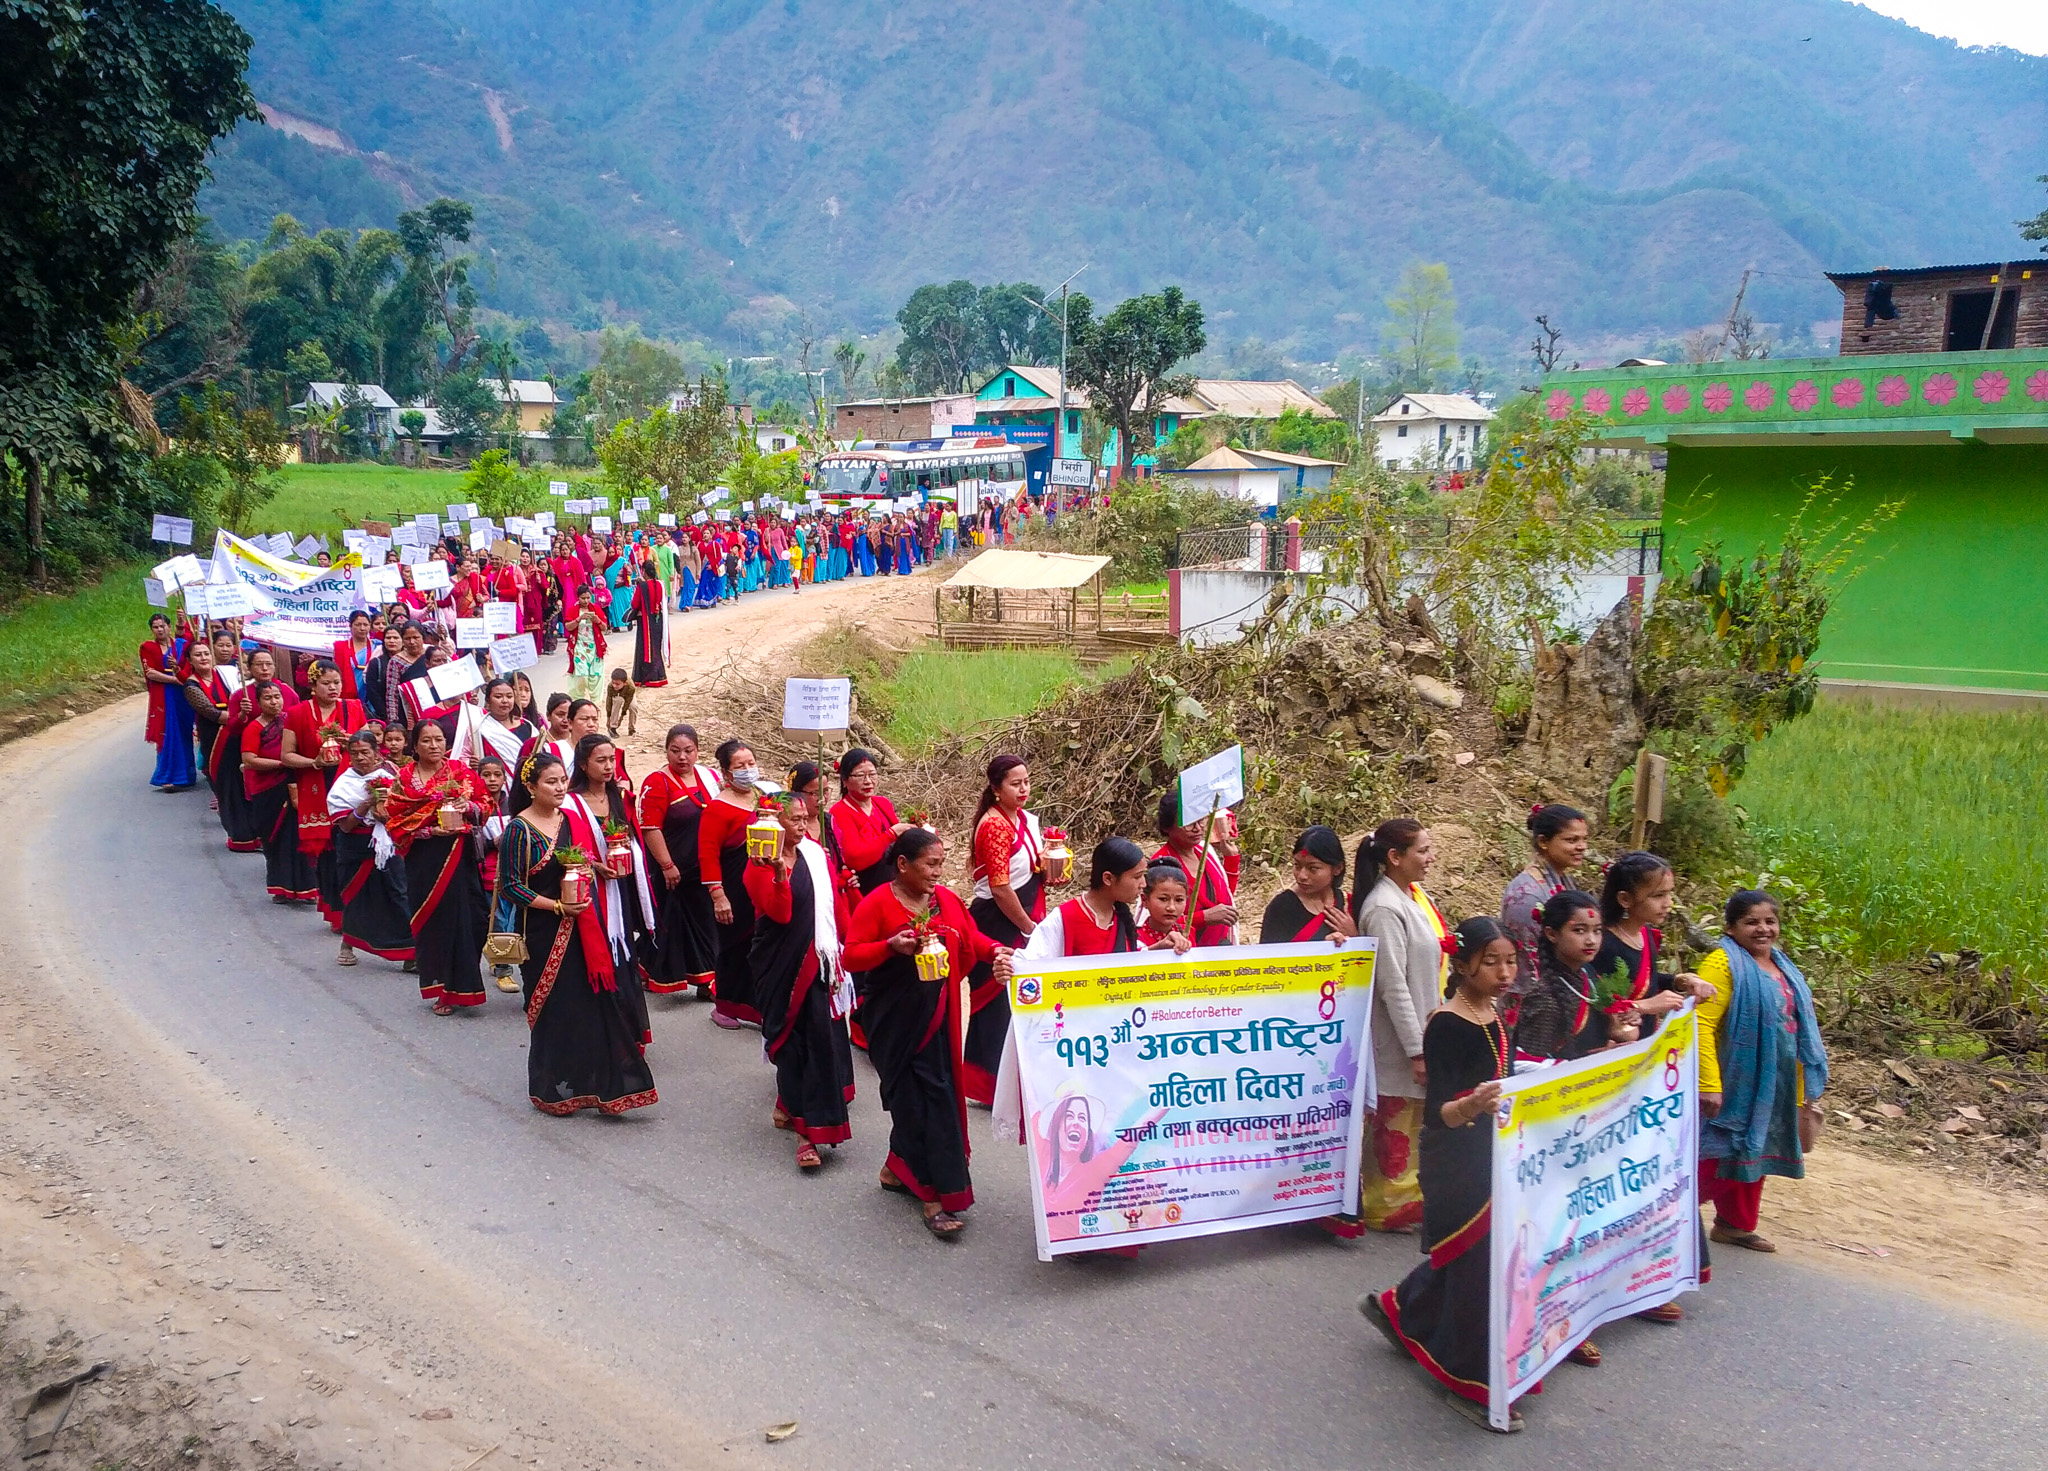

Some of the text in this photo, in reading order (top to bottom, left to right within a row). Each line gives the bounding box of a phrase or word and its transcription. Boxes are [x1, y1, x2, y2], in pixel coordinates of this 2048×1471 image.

[820, 459, 886, 470] ARYAN'S
[1053, 475, 1089, 484] BHINGRI
[313, 597, 339, 611] दिवस
[1182, 985, 1217, 996] Technology
[1217, 984, 1230, 995] for
[1230, 982, 1254, 994] Gender
[1255, 981, 1285, 992] Equality
[1151, 1005, 1243, 1022] #BalanceforBetter
[1056, 1034, 1109, 1068] ११३
[1137, 1017, 1345, 1061] अन्तर्राष्ट्रिय
[1149, 1072, 1227, 1108] महिला
[1236, 1067, 1305, 1102] दिवस
[1162, 1120, 1191, 1139] तथा
